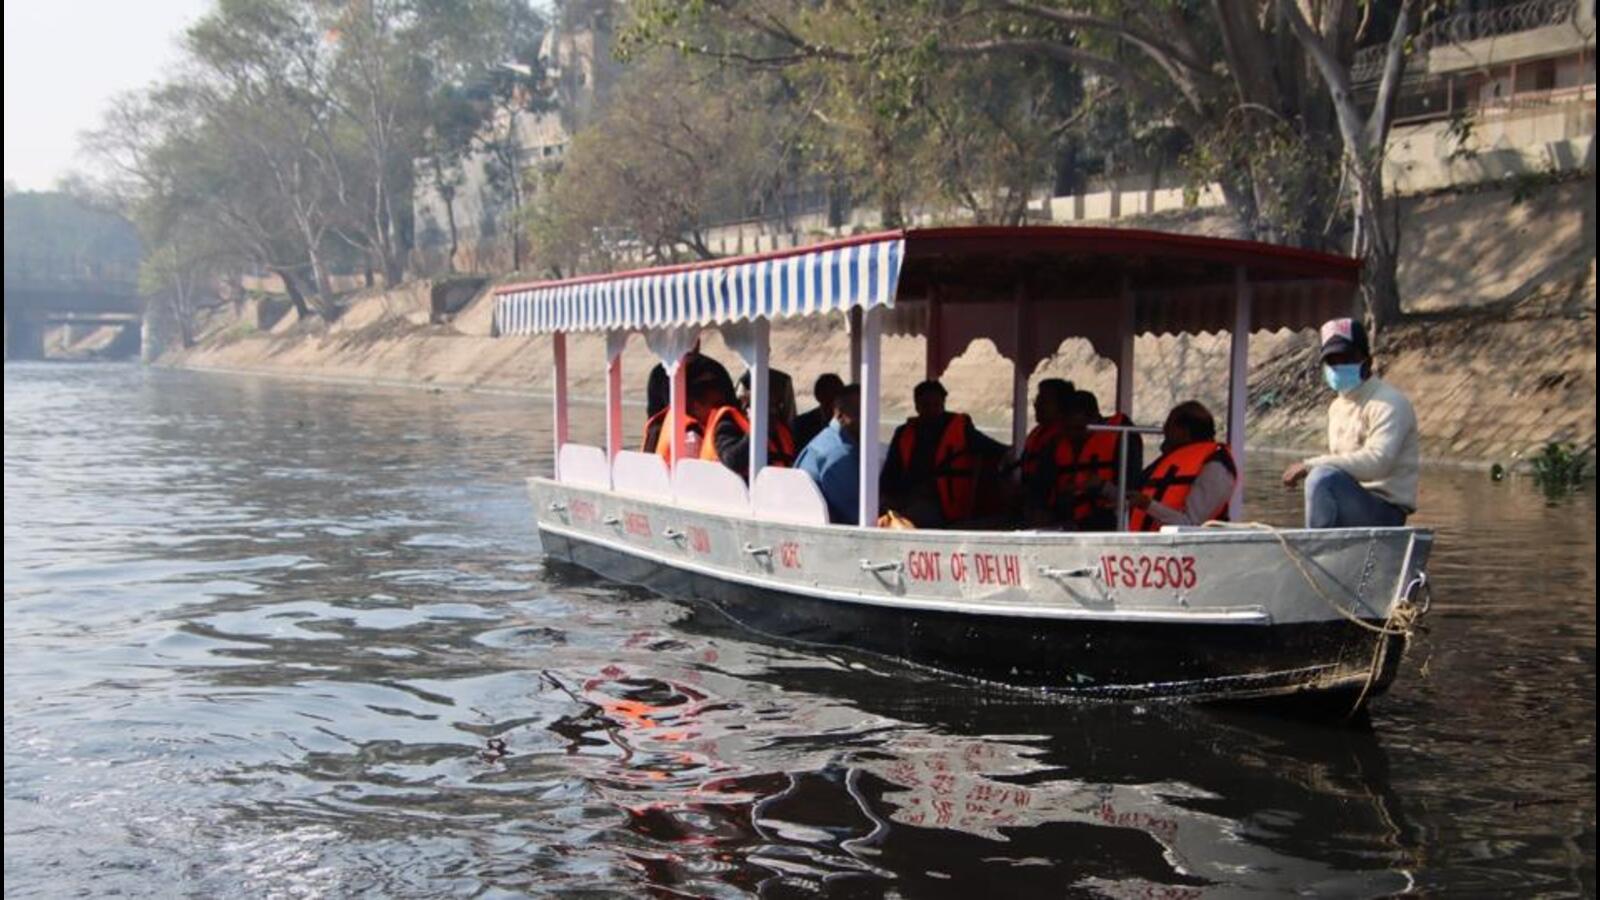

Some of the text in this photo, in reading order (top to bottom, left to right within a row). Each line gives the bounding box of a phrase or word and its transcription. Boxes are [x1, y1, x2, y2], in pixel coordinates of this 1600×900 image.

[908, 550, 1022, 586] GOVT OF DELHI
